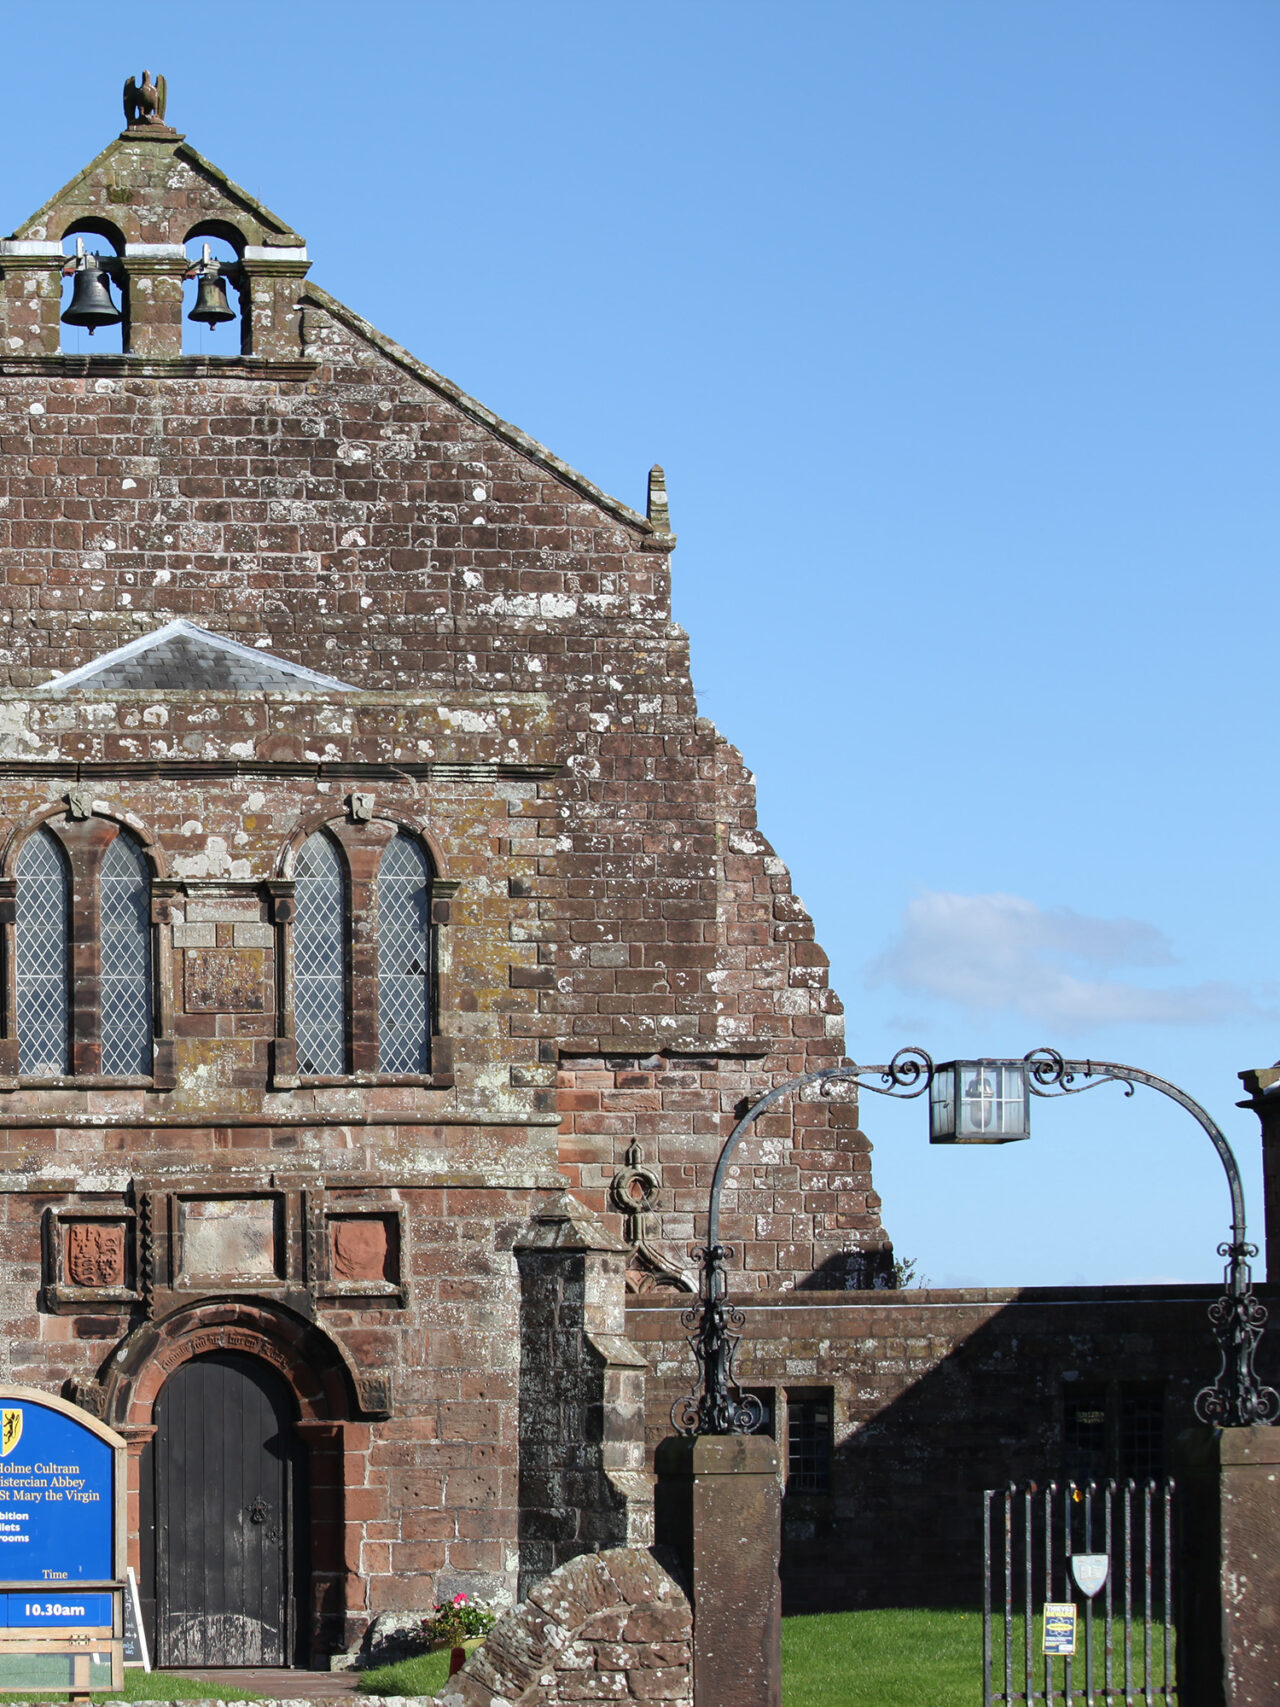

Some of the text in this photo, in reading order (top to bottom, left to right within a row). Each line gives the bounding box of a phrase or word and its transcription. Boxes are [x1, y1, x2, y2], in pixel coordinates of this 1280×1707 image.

[34, 1462, 80, 1474] Cultram
[50, 1476, 86, 1490] Abbey
[13, 1490, 42, 1503] Mary
[45, 1489, 63, 1501] the
[65, 1489, 100, 1503] Virgin
[42, 1569, 68, 1580] Time
[25, 1604, 86, 1617] 10.30am
